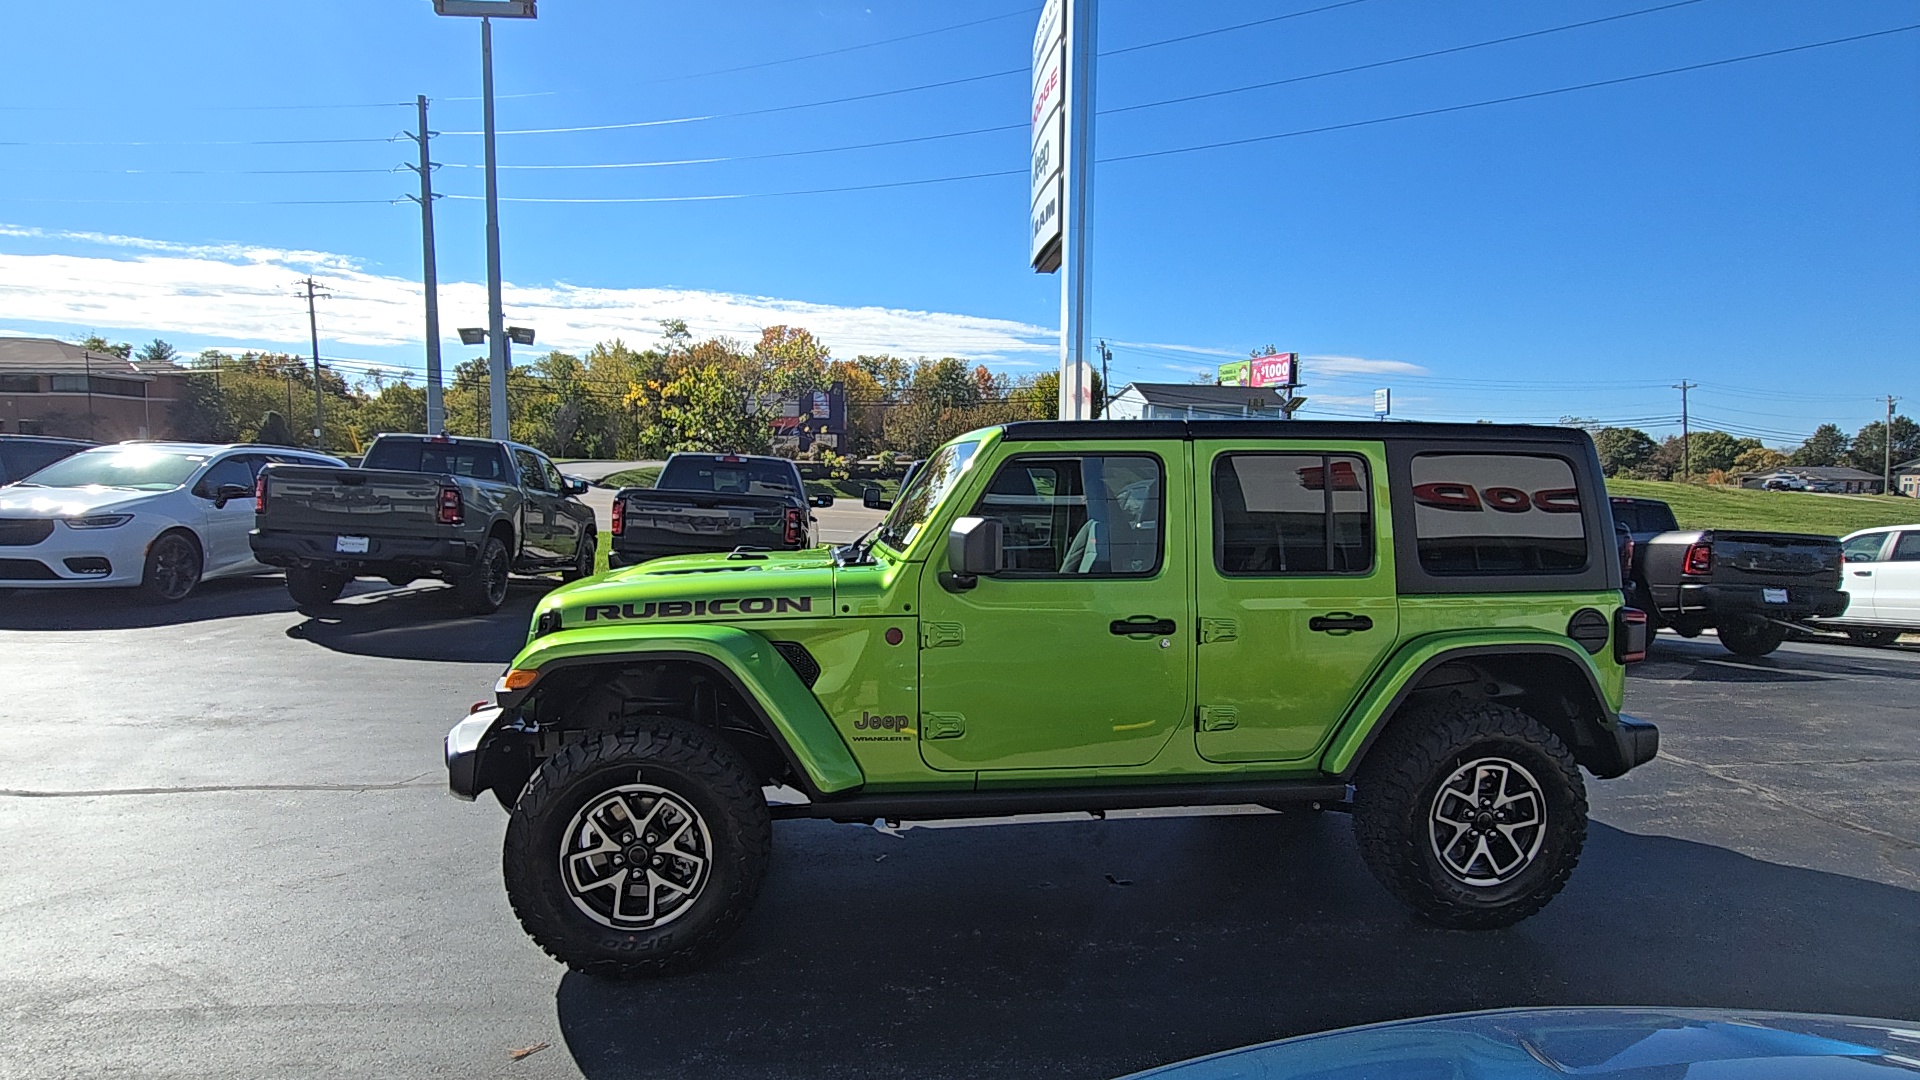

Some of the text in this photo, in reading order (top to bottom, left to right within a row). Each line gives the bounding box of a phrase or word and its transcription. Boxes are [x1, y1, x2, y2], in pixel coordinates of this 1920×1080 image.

[1034, 197, 1056, 238] RAM
[1261, 362, 1288, 378] $1000
[584, 596, 812, 622] RUBICON
[853, 711, 909, 733] Jeep
